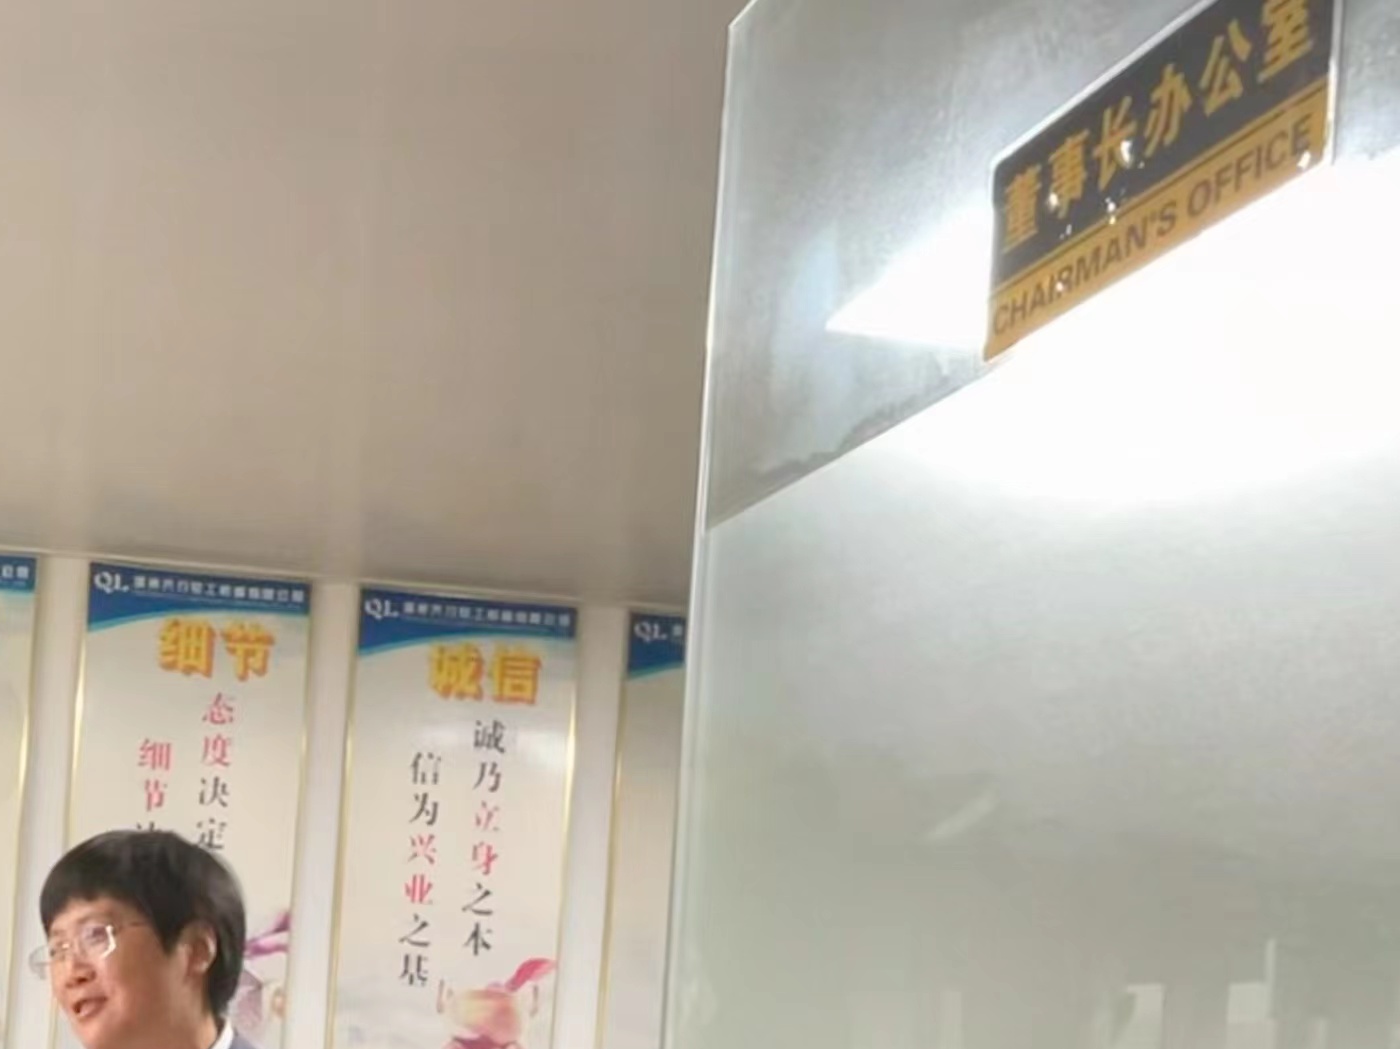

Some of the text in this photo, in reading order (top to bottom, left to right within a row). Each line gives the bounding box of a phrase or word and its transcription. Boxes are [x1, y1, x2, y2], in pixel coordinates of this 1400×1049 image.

[1002, 0, 1314, 252] 董事长办公室
[993, 113, 1312, 335] CHAIRMAN'S OFFICE
[157, 616, 276, 682] 细节
[428, 641, 543, 705] 诚信
[137, 738, 172, 832] 细节
[197, 692, 235, 849] 态度决定
[461, 720, 506, 956] 诚乃立身之本
[398, 752, 441, 986] 信为兴业之基
